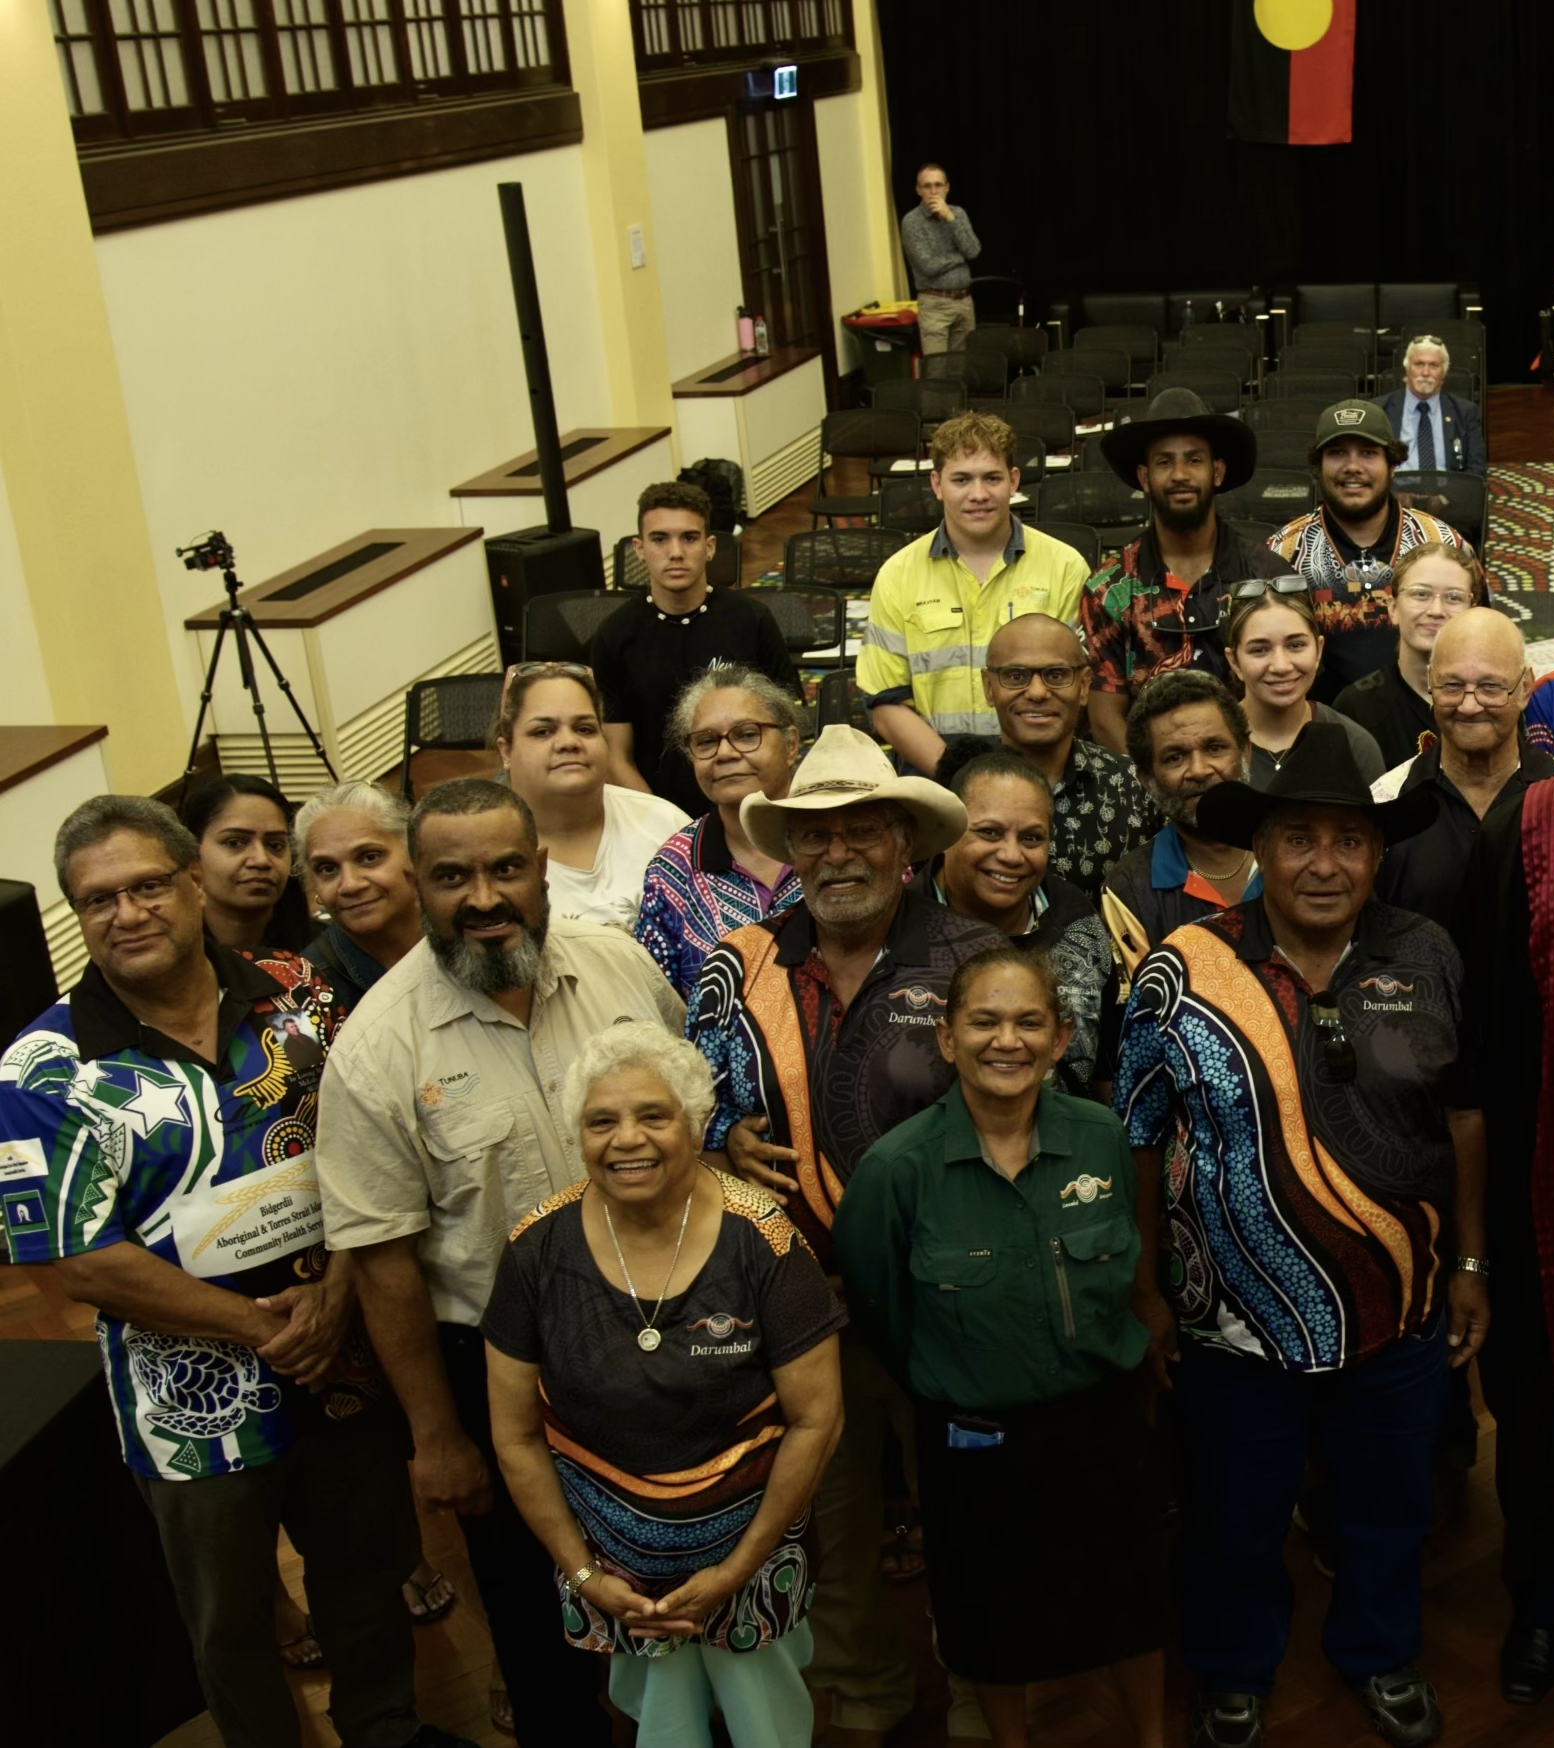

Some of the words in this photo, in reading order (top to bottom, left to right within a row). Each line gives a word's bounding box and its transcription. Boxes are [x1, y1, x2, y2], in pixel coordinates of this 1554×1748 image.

[1363, 1000, 1413, 1012] Darumbal
[259, 1196, 294, 1218] Bidgerdii
[216, 1226, 260, 1249] Aboriginal
[260, 1223, 269, 1234] &
[268, 1216, 292, 1231] Torres
[291, 1208, 311, 1222] Strait
[310, 1201, 322, 1214] Isla
[235, 1236, 282, 1259] Community
[282, 1226, 306, 1243] Health
[307, 1219, 324, 1234] Servi
[690, 1340, 752, 1357] Darumbal
